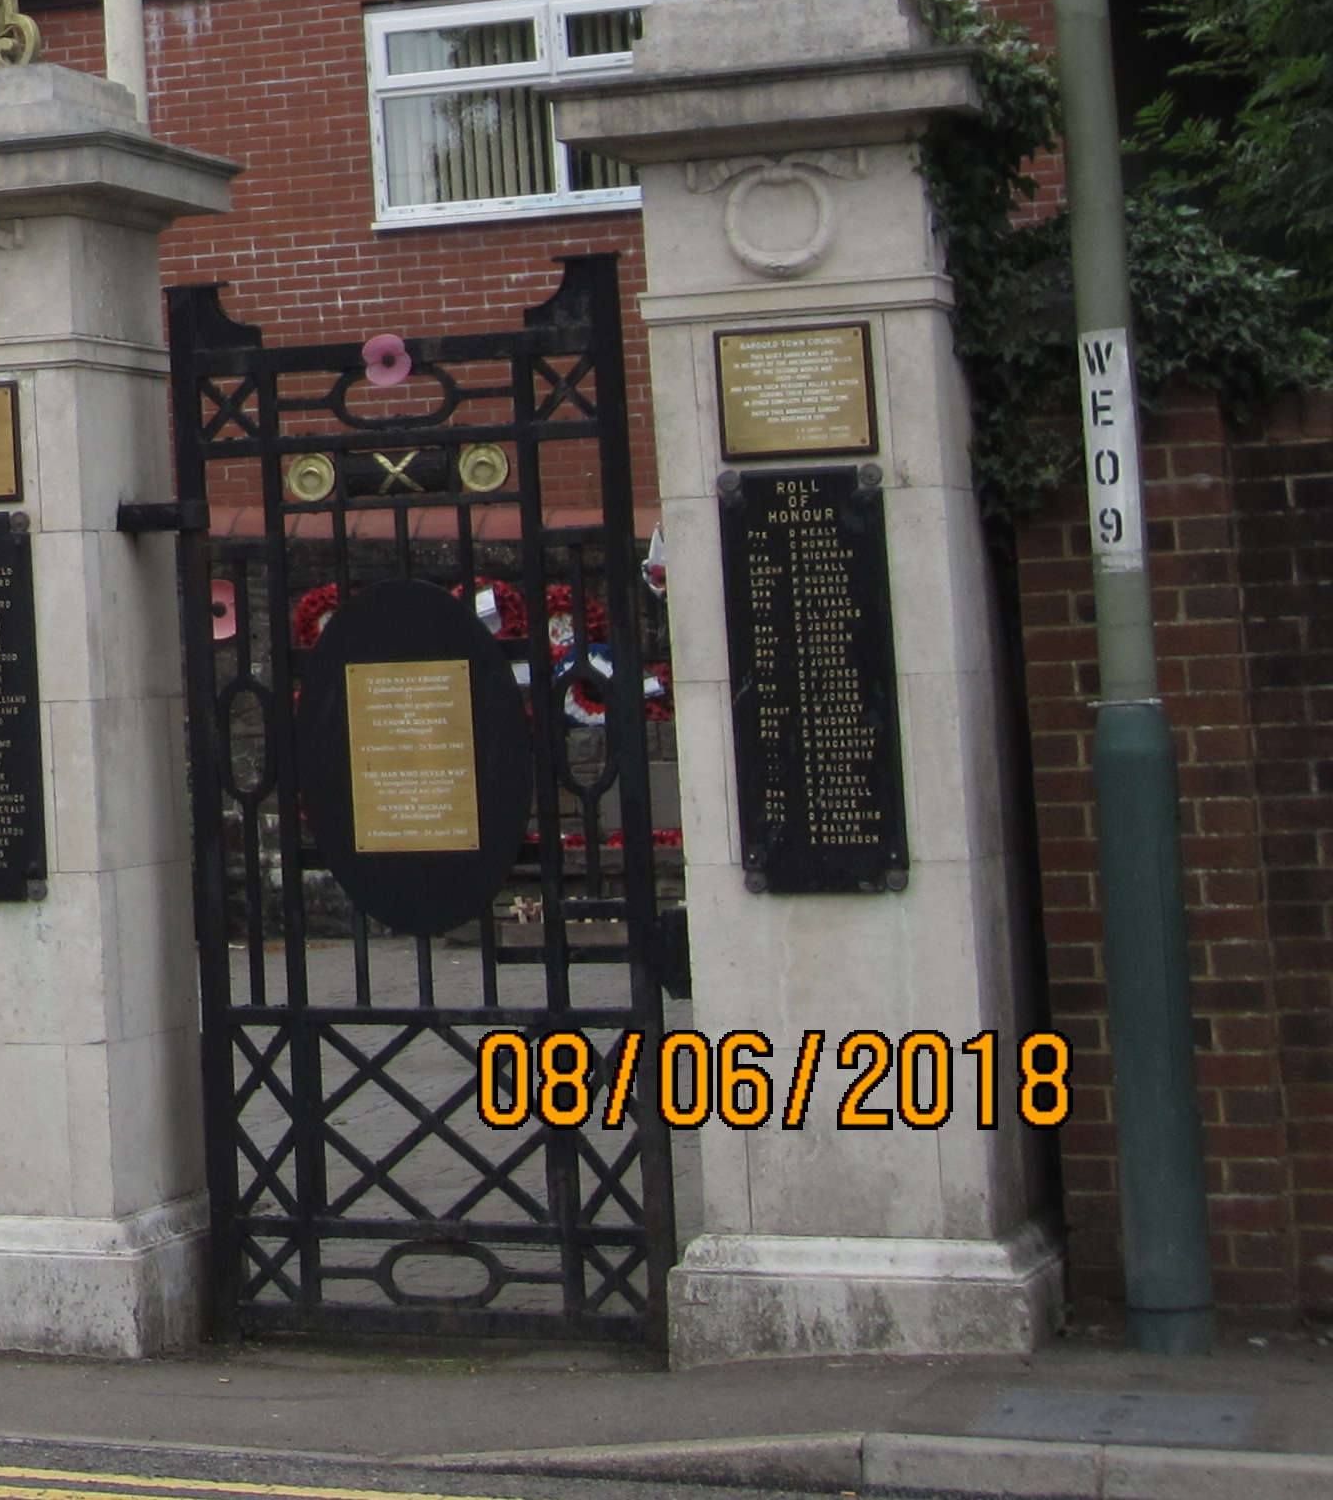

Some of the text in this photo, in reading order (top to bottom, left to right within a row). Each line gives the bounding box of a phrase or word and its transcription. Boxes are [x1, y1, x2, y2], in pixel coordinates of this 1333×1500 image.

[776, 480, 819, 494] ROLL
[788, 495, 809, 508] OF
[768, 508, 834, 523] HONOUR
[801, 527, 837, 536] HEALY
[802, 550, 853, 560] HICKMAN
[815, 563, 845, 571] HALL
[804, 574, 849, 584] HUGHES
[805, 586, 847, 596] HARRIS
[818, 598, 851, 607] ISAAC
[825, 609, 861, 619] JONES
[808, 622, 845, 631] JONES
[809, 634, 852, 643] JORDAN
[809, 645, 845, 654] JONES
[811, 657, 845, 666] JONES
[822, 669, 858, 678] JONES
[822, 680, 858, 689] JONES
[823, 692, 859, 701] JONES
[828, 704, 864, 713] LACEY
[818, 763, 852, 772] PRICE
[830, 776, 867, 784] PERRY
[820, 788, 871, 796] PURNELL
[821, 824, 860, 832] RALPH
[823, 835, 879, 843] ROBINSON
